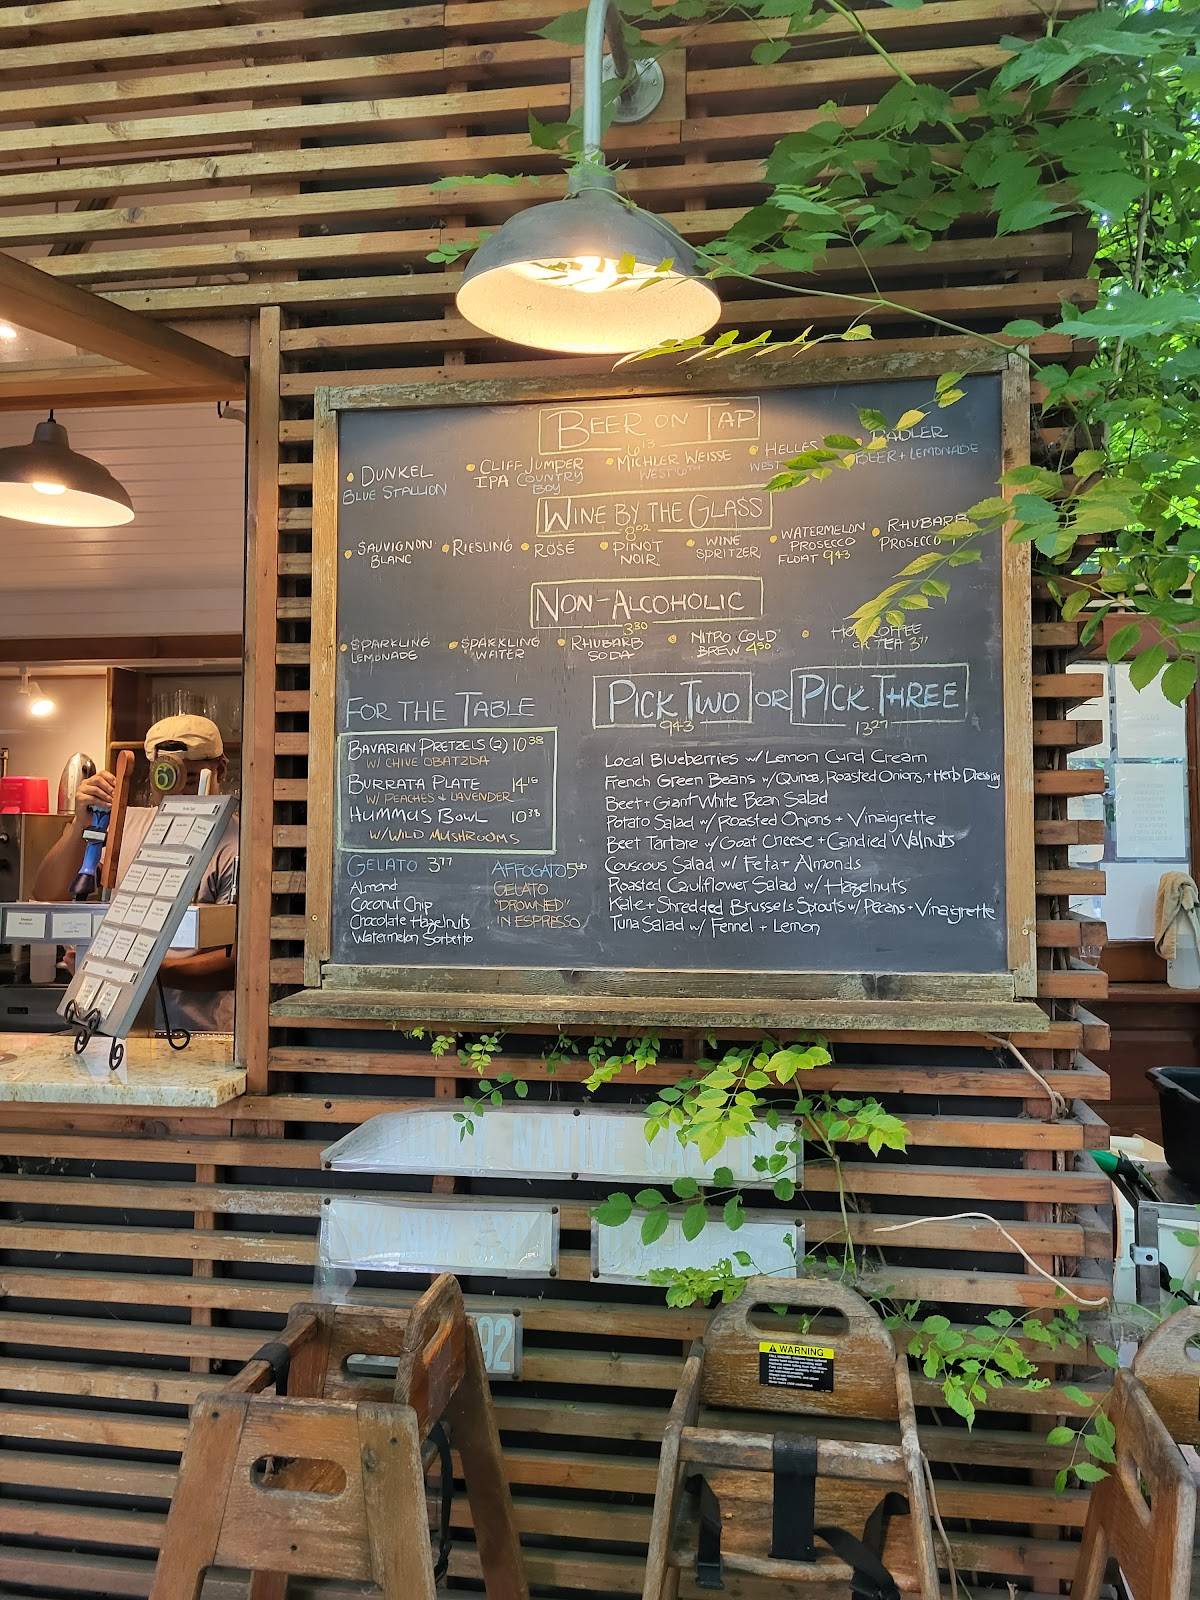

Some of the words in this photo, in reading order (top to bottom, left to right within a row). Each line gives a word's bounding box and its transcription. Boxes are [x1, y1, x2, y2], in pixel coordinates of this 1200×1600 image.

[547, 411, 646, 450] BEER
[655, 413, 689, 428] ON
[695, 402, 757, 440] TAP
[684, 449, 732, 464] WEISSE
[765, 441, 818, 456] HELLES
[910, 443, 978, 460] LEMONADE
[480, 460, 523, 474] CLIFF
[525, 456, 584, 474] JUMPER
[750, 460, 782, 472] WEST
[362, 464, 434, 487] DUNKEL
[474, 475, 509, 489] IPA
[516, 471, 584, 487] COUNTRY
[640, 468, 671, 480] WEST
[343, 489, 376, 505] BLUE
[383, 483, 447, 499] STALLION
[533, 483, 561, 495] BOY
[545, 497, 606, 532] WINE
[615, 502, 639, 526] BY
[647, 502, 684, 523] THE
[689, 495, 763, 528] GLASS
[781, 522, 865, 539] WATERMELON
[358, 540, 432, 556] SAUVIGNON
[453, 537, 513, 557] RIESLING
[534, 539, 576, 558] ROSÉ
[613, 540, 663, 556] PINOT
[705, 534, 741, 546] WINE
[789, 537, 855, 551] PROSECCO
[879, 535, 941, 551] PROSECCO
[371, 555, 412, 568] BLANC
[696, 547, 761, 562] SPRITZER
[778, 554, 818, 565] FLOAT
[536, 587, 744, 622] NON-ALCOHOLIC
[350, 637, 431, 650] SPARKLING
[571, 635, 644, 650] RHUBARB
[691, 630, 732, 643] NITRO
[739, 629, 777, 642] COLD
[874, 637, 904, 650] TEA
[351, 649, 418, 663] LEMONADE
[476, 649, 525, 660] WATER
[588, 650, 635, 661] SODA
[697, 645, 741, 658] BREW
[609, 679, 678, 722] PICK
[680, 680, 740, 720] TWO
[755, 689, 791, 710] OR
[798, 674, 869, 719] PICK
[870, 674, 959, 717] THREE
[346, 697, 391, 728] FOR
[398, 700, 447, 722] THE
[455, 692, 536, 726] TABLE
[347, 740, 416, 760] BAVARIAN
[419, 737, 485, 756] PRETZELS
[489, 736, 508, 754] (2)
[386, 757, 418, 767] CHIVE
[423, 755, 490, 767] OBATZDA
[605, 753, 644, 767] Local
[650, 751, 739, 767] Blueberries
[824, 749, 864, 763] Curd
[870, 749, 928, 763] Cream
[347, 774, 425, 794] BURRATA
[432, 774, 480, 791] PLATE
[605, 775, 650, 790] French
[656, 773, 703, 788] Green
[708, 773, 756, 788] Beans
[826, 769, 876, 784] Roasted
[933, 766, 961, 782] Herb
[963, 768, 1000, 789] Dressing
[384, 792, 435, 804] PEACHES
[451, 791, 515, 803] LAVENDER
[605, 795, 643, 811] Beet
[653, 792, 699, 810] Giant
[699, 792, 738, 809] White
[743, 791, 780, 809] Bean
[784, 789, 828, 807] Salad
[350, 806, 432, 824] HUMMUS
[438, 807, 489, 823] BOWL
[607, 815, 650, 832] Potato
[654, 814, 694, 831] Salad
[781, 811, 831, 827] Onions
[847, 807, 937, 832] Vinaigrette
[429, 829, 520, 844] MUSHROOMS
[607, 836, 641, 853] Beet
[645, 835, 699, 850] Tartare
[762, 833, 814, 849] Cheese
[827, 832, 886, 850] Candied
[892, 830, 955, 849] Walnuts
[347, 855, 417, 877] GELATO
[491, 860, 567, 878] AFFOGATO
[605, 856, 667, 874] Couscous
[672, 856, 715, 874] Salad
[743, 854, 779, 872] Feta
[794, 854, 862, 872] Almonds
[350, 878, 398, 895] Almond
[493, 881, 549, 897] GELATO
[608, 876, 661, 893] Roasted
[667, 876, 748, 893] Cauliflower
[752, 875, 797, 894] Salad
[351, 896, 401, 912] Coconut
[403, 896, 433, 915] Chip
[609, 896, 645, 911] Kale
[657, 896, 723, 915] Shredded
[730, 898, 794, 915] Brussels
[797, 897, 846, 916] Sprouts
[864, 898, 906, 915] Pecans
[915, 897, 996, 924] Vinaigrette
[350, 913, 406, 929] Chocolate
[410, 914, 470, 934] Hazelnuts
[497, 914, 511, 928] IN
[515, 914, 580, 928] ESPRESSO
[610, 914, 639, 931] Tuna
[642, 916, 684, 932] Salad
[711, 917, 753, 938] Fennel
[773, 918, 820, 935] Lemon
[352, 929, 419, 944] Watermelon
[423, 932, 473, 946] Sorbetto
[779, 1345, 824, 1357] WARNING
